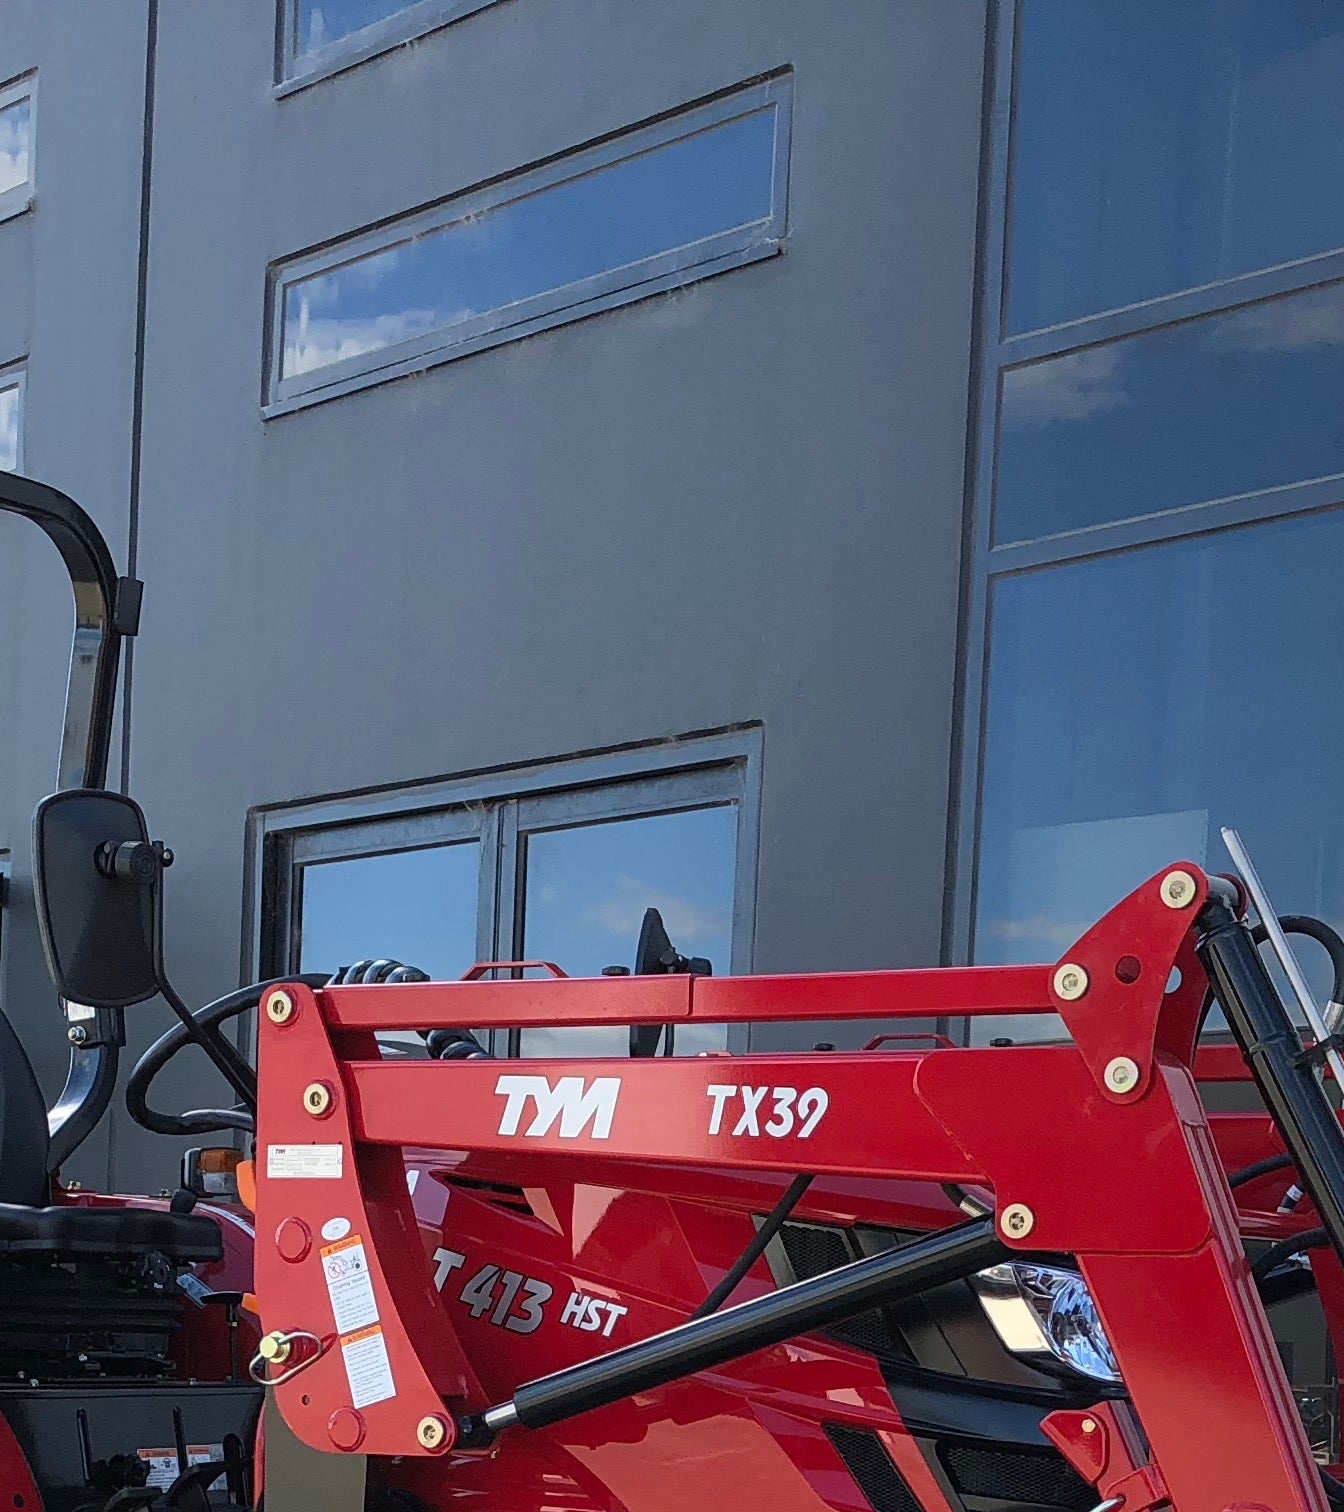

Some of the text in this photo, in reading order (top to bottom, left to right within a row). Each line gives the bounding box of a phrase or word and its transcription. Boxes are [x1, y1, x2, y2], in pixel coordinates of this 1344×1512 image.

[494, 1075, 830, 1140] TYM TX39
[559, 1292, 629, 1338] HST
